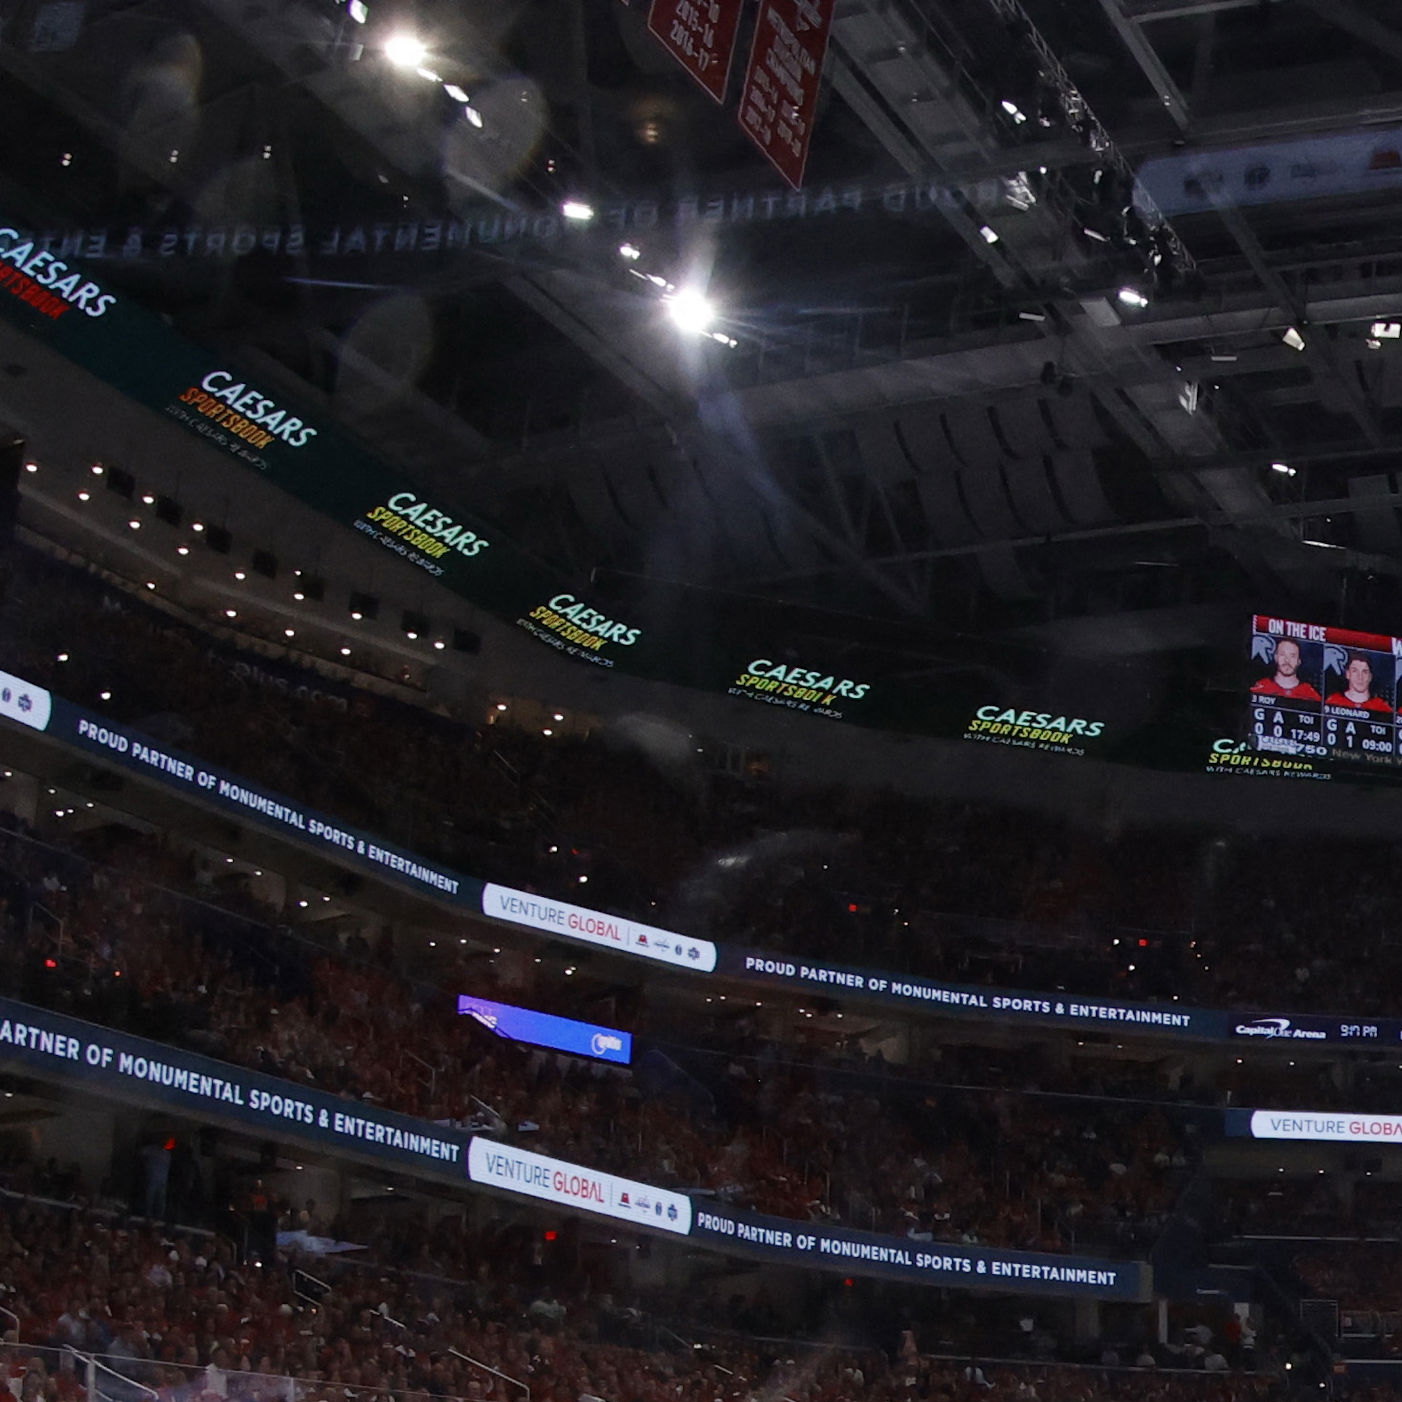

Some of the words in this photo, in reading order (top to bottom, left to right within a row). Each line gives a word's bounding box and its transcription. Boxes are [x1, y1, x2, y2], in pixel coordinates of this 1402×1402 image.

[201, 370, 317, 448] CAESARS
[387, 491, 489, 558] CAESARS
[1268, 619, 1284, 635] ON
[1286, 622, 1306, 639] THE
[1309, 624, 1326, 641] ICE
[975, 705, 1104, 738] CAESARS
[78, 719, 128, 754] PROUD
[132, 743, 194, 782] PARTNER
[197, 772, 216, 790] OF
[218, 778, 306, 830] MONUMENTAL
[309, 820, 354, 853] SPORTS
[357, 840, 366, 855] &
[368, 843, 459, 895] ENTERTAINMENT
[500, 895, 566, 926] VENTURE
[567, 914, 622, 942] GLOBAL
[1270, 1118, 1345, 1134] VENTURE
[698, 1213, 735, 1236] PROUD
[738, 1223, 792, 1248] PARTNER
[796, 1235, 815, 1251] OF
[820, 1238, 912, 1266] MONUMENTAL
[916, 1253, 972, 1273] SPORTS
[976, 1259, 987, 1274] &
[992, 1262, 1116, 1287] ENTERTAINMENT
